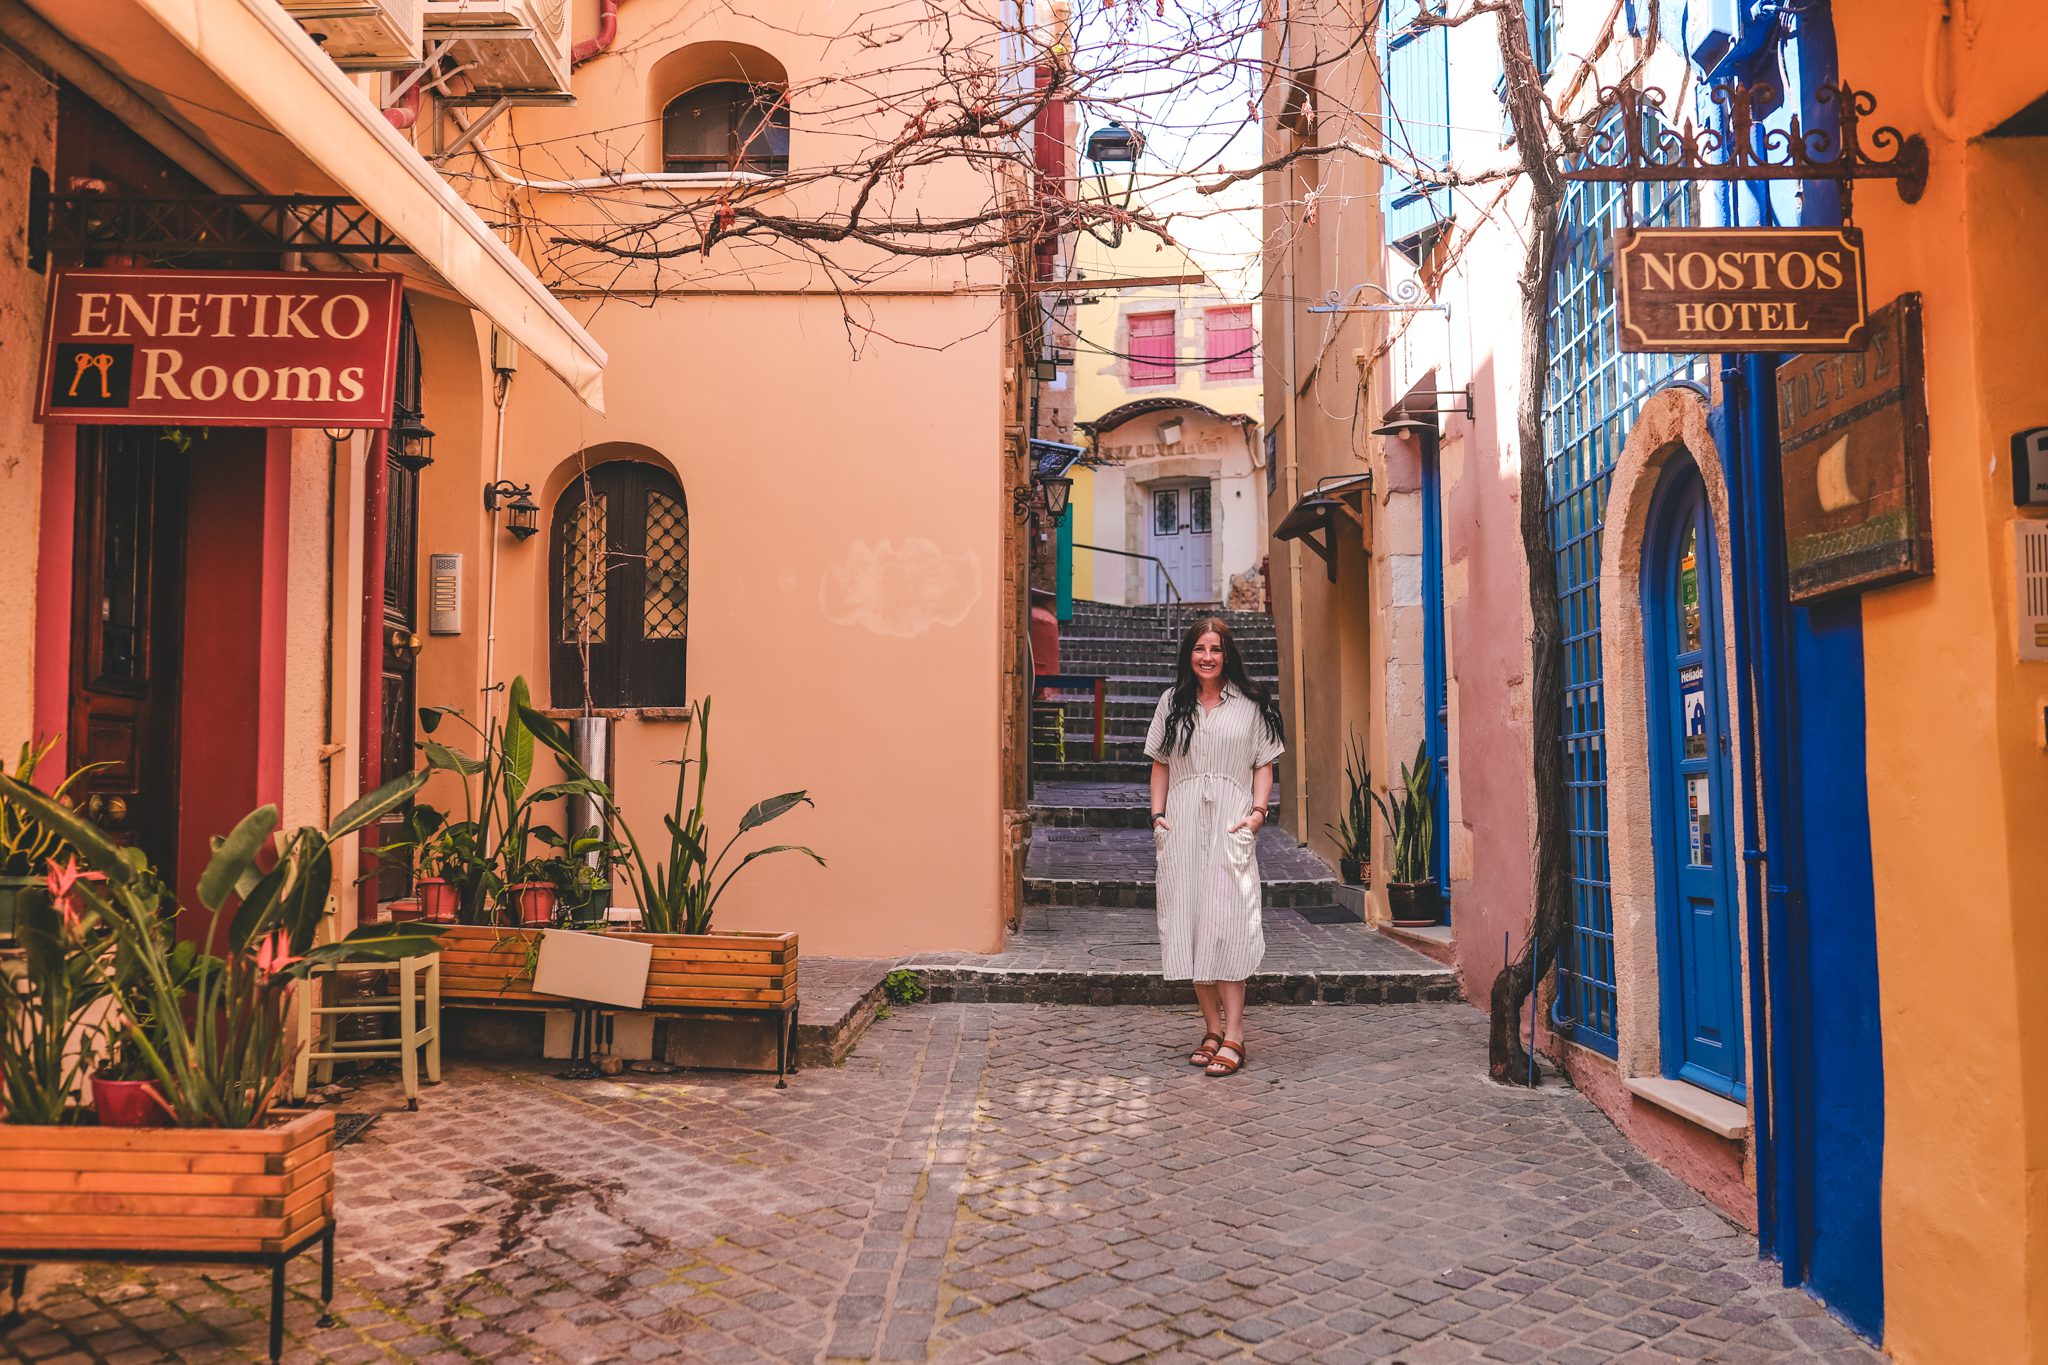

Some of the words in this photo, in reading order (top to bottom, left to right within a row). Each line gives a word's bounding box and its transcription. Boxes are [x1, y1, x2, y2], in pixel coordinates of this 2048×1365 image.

[1640, 251, 1844, 291] NOSTOS
[71, 292, 370, 340] ENETIKO
[1676, 302, 1809, 332] HOTEL
[136, 348, 366, 403] Rooms
[1681, 667, 1703, 683] Héliade
